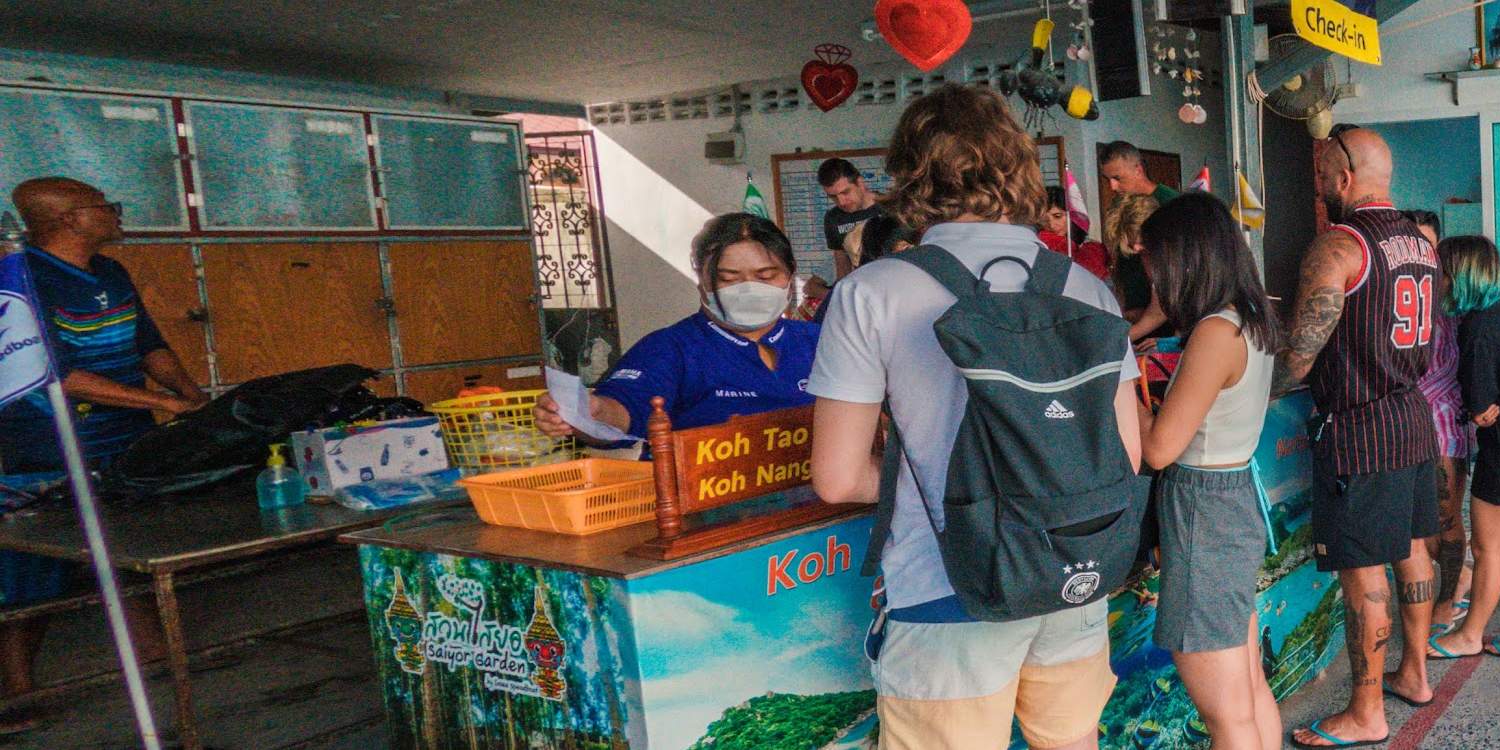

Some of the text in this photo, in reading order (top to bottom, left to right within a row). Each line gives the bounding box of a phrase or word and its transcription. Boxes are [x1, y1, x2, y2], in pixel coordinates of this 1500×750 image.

[1305, 7, 1366, 50] Check-in
[1379, 236, 1438, 271] RODMAN
[1390, 274, 1433, 349] 91
[715, 389, 758, 398] MARINE
[1044, 410, 1075, 419] adidas
[696, 427, 809, 465] Koh Tao
[698, 470, 746, 501] Koh
[767, 535, 851, 596] Koh
[474, 651, 526, 673] Garden
